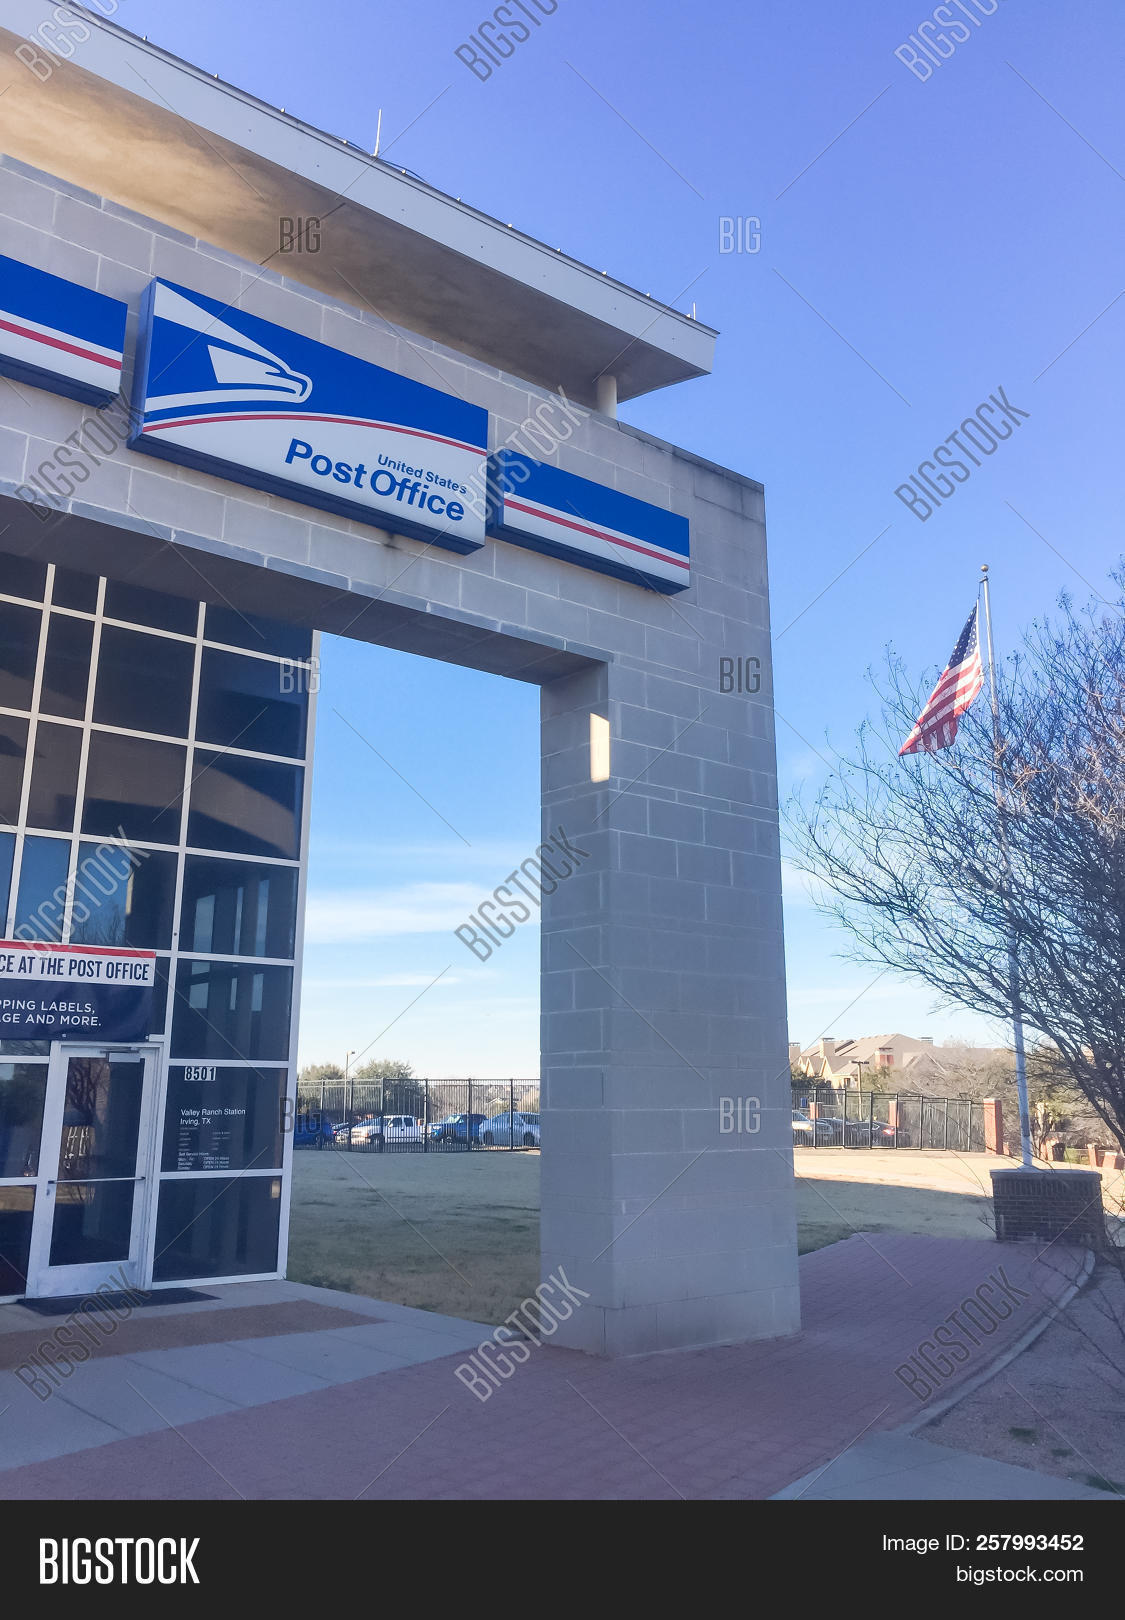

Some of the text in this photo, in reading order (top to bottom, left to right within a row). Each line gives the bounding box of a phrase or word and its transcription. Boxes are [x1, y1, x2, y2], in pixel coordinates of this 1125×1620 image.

[285, 438, 465, 521] Post Office
[377, 453, 468, 495] United States
[18, 956, 35, 974] AT
[39, 957, 65, 976] THE
[68, 959, 102, 978] POST
[106, 961, 149, 981] OFFICE
[0, 999, 95, 1014] PING LABELS,
[0, 1012, 102, 1027] GE AND MORE.
[185, 1066, 216, 1081] 8501
[180, 1108, 246, 1117] Valley Ranch Station
[201, 1117, 212, 1125] TX
